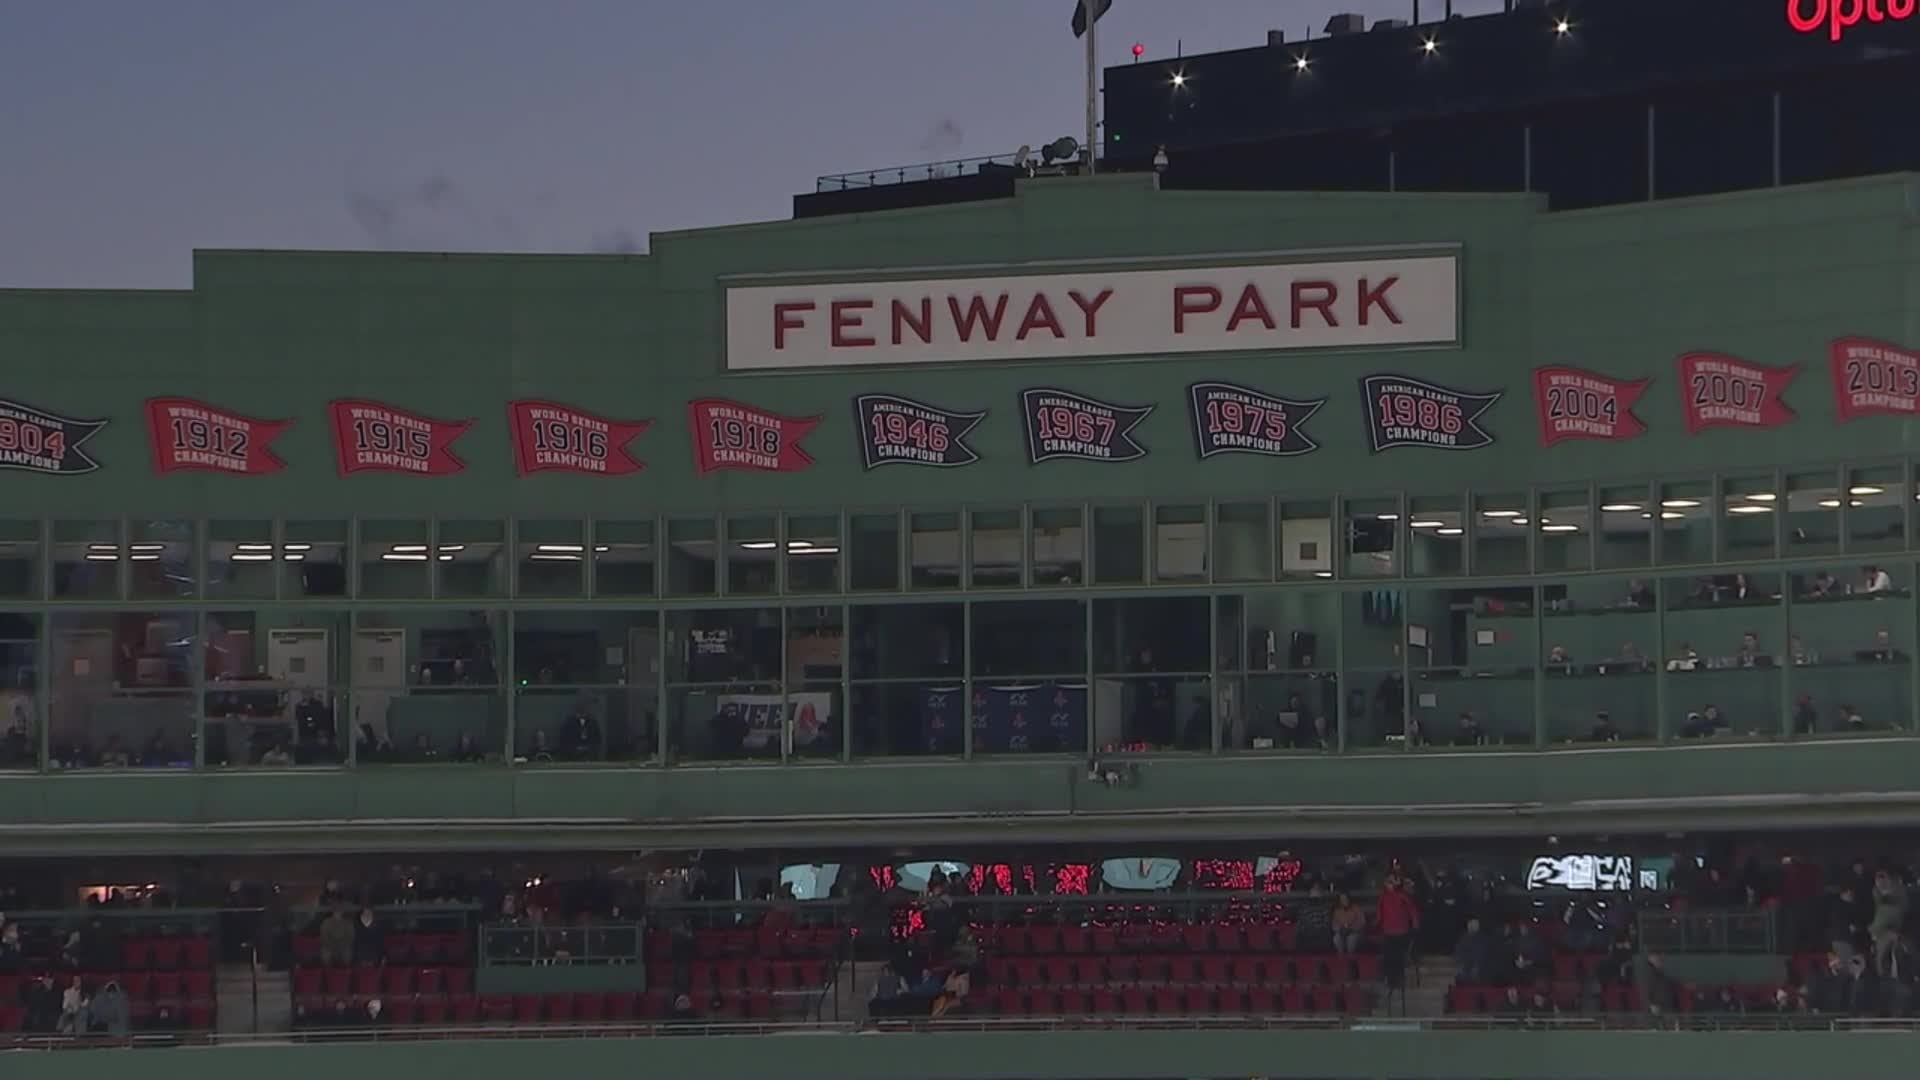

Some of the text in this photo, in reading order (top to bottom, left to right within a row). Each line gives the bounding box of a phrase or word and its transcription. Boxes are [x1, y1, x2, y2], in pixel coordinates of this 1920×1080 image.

[1788, 0, 1920, 41] Optu
[774, 277, 1403, 350] FENWAY PARK
[1847, 359, 1919, 398] 2013
[1207, 392, 1282, 411] AMERICAN LEAGUE
[1381, 385, 1459, 404] AMERICAN LEAGUE
[1692, 374, 1765, 411] 2007
[168, 407, 208, 421] WORLD
[873, 404, 946, 424] AMERICAN LEAGUE
[1039, 398, 1113, 417] AMERICAN LEAGUE
[1379, 394, 1462, 434] 1986
[1547, 386, 1616, 424] 2004
[351, 408, 431, 432] WORLD SERIES
[530, 409, 608, 432] WORLD SERIES
[708, 407, 781, 429] WORLD SERIES
[1037, 407, 1116, 446] 1967
[1207, 400, 1287, 440] 1975
[172, 418, 248, 460] 1912
[354, 419, 431, 460] 1915
[533, 419, 607, 460] 1916
[711, 418, 780, 456] 1918
[871, 413, 949, 452] 1946
[1213, 433, 1281, 451] CHAMPIONS
[1386, 427, 1456, 445] CHAMPIONS
[713, 450, 778, 468] CHAMPIONS
[878, 445, 944, 463] CHAMPIONS
[1043, 439, 1110, 457] CHAMPIONS
[173, 450, 247, 471] CHAMPIONS
[357, 451, 429, 472] CHAMPIONS
[536, 451, 606, 472] CHAMPIONS
